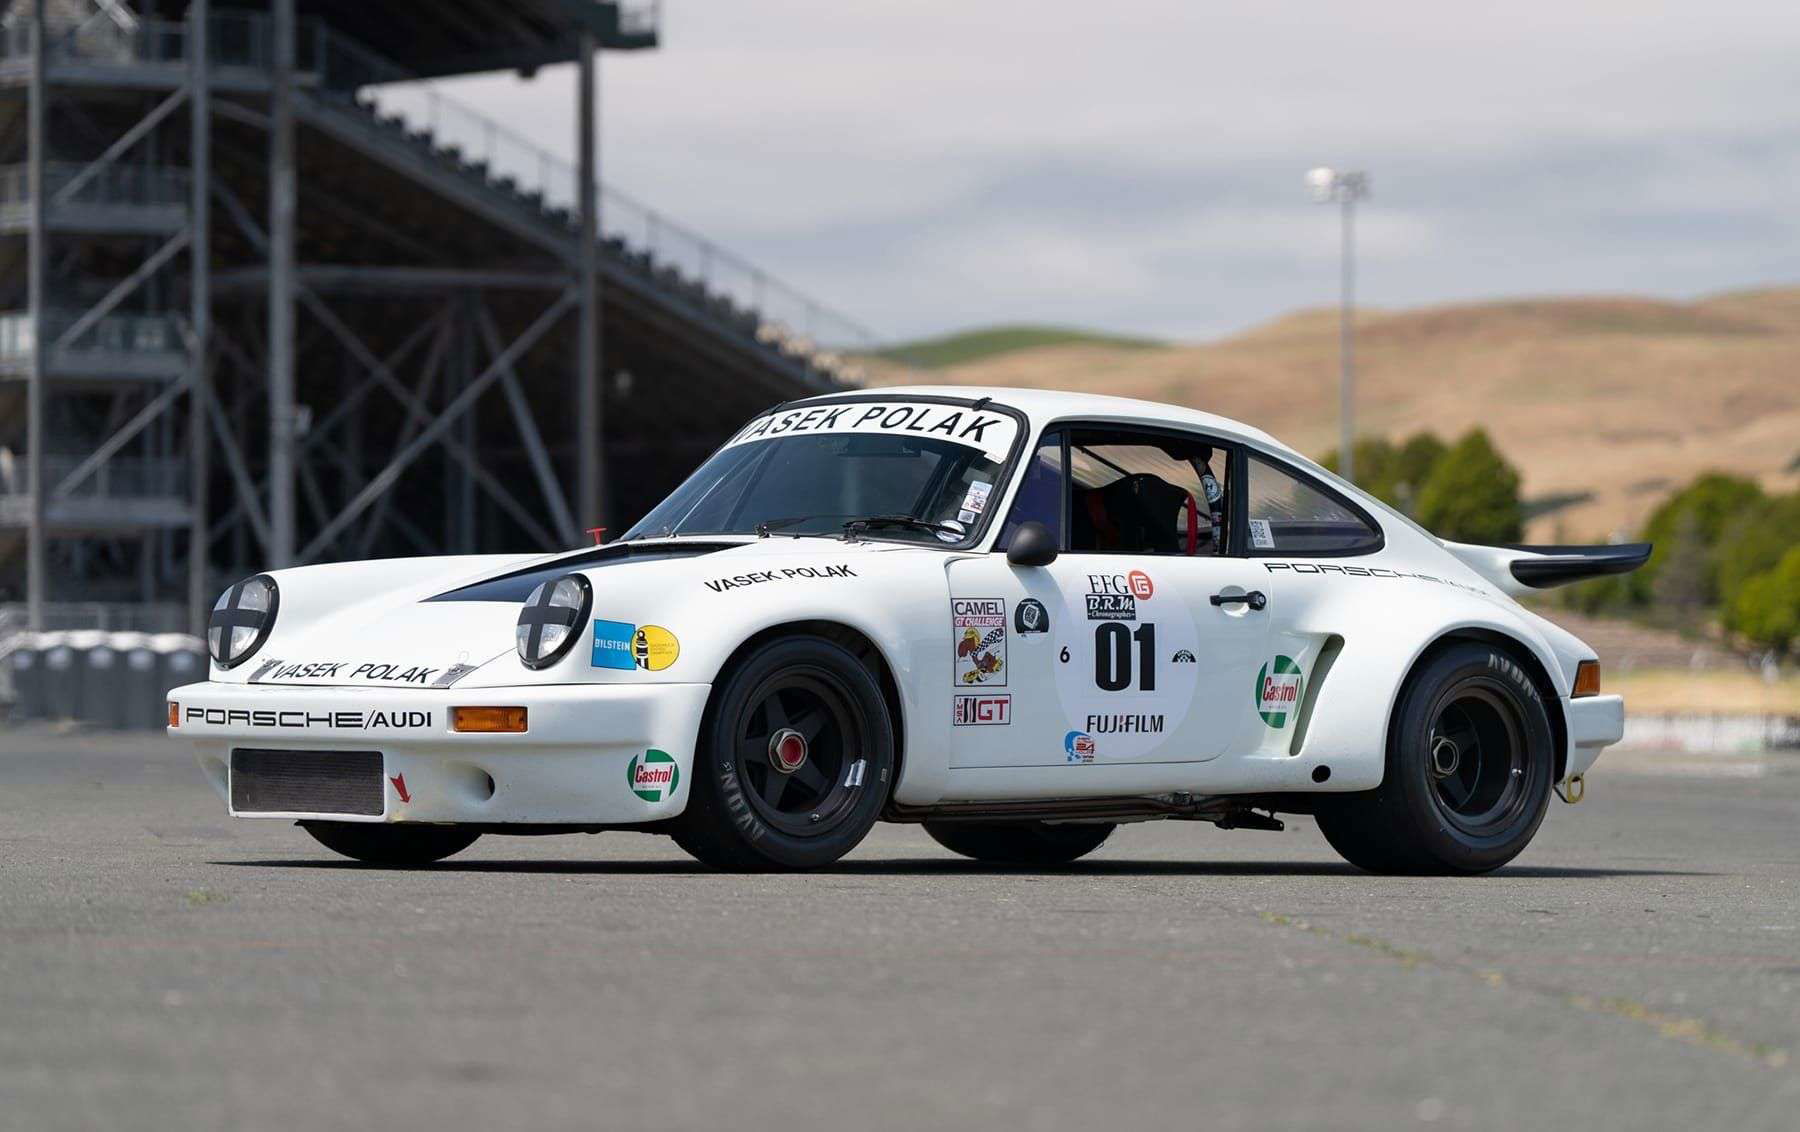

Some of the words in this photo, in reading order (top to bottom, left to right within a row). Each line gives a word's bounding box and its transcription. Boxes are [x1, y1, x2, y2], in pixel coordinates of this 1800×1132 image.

[732, 407, 852, 444] VASEK
[852, 406, 1002, 443] POLAK
[704, 570, 782, 593] VASEK
[780, 563, 858, 580] POLAK
[1087, 574, 1129, 594] EFG
[954, 601, 1003, 616] CAMEL
[955, 617, 965, 627] GT
[965, 617, 1003, 627] CHALLENGE
[594, 639, 630, 651] BILSTEIN
[1059, 645, 1070, 664] 6
[1095, 622, 1155, 691] 01
[271, 662, 349, 679] VASEK
[350, 663, 439, 684] POLAK
[1263, 676, 1299, 702] Castrol
[186, 707, 432, 731] PORSCHE/AUDI
[978, 699, 1009, 721] GT
[1086, 714, 1164, 734] FUJIFILM
[635, 764, 673, 784] Castrol
